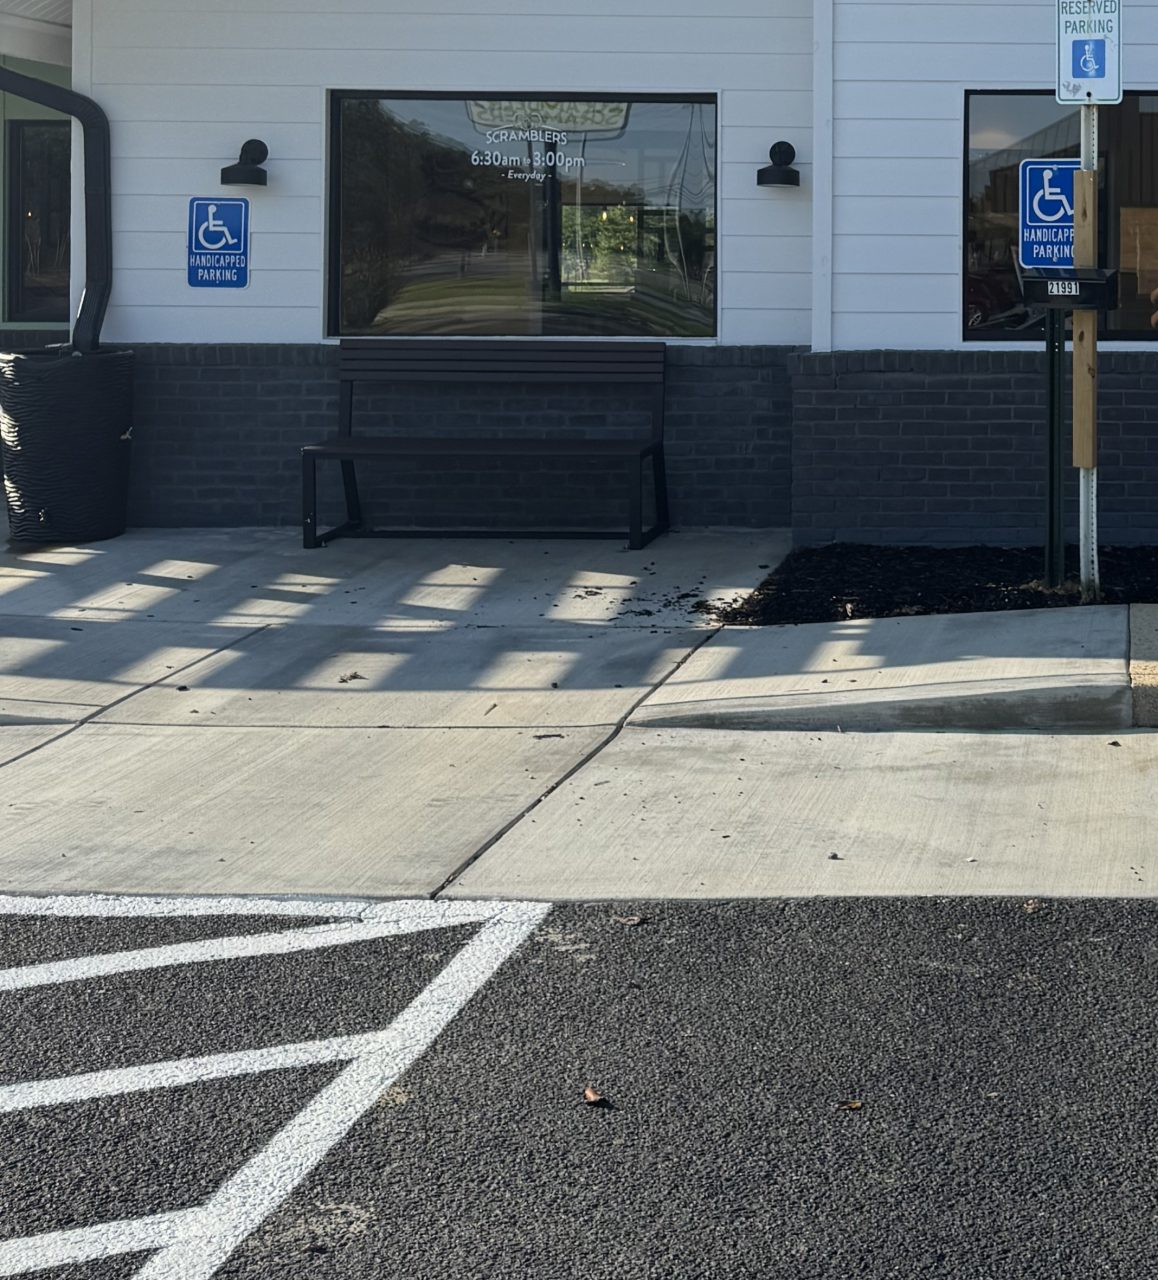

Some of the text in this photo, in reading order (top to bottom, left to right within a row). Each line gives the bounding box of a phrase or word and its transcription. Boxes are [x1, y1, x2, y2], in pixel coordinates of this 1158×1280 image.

[1061, 0, 1117, 15] RESERVED
[1064, 19, 1114, 35] PARKING
[486, 130, 567, 145] SCRAMBLERS
[471, 150, 520, 166] 6:30am
[533, 151, 585, 173] 3:00pm
[507, 169, 546, 182] Everyday
[1023, 228, 1075, 242] HANDICAPP
[190, 255, 246, 268] HANDICAPPED
[198, 269, 238, 281] PARKING
[1049, 282, 1078, 294] 21991
